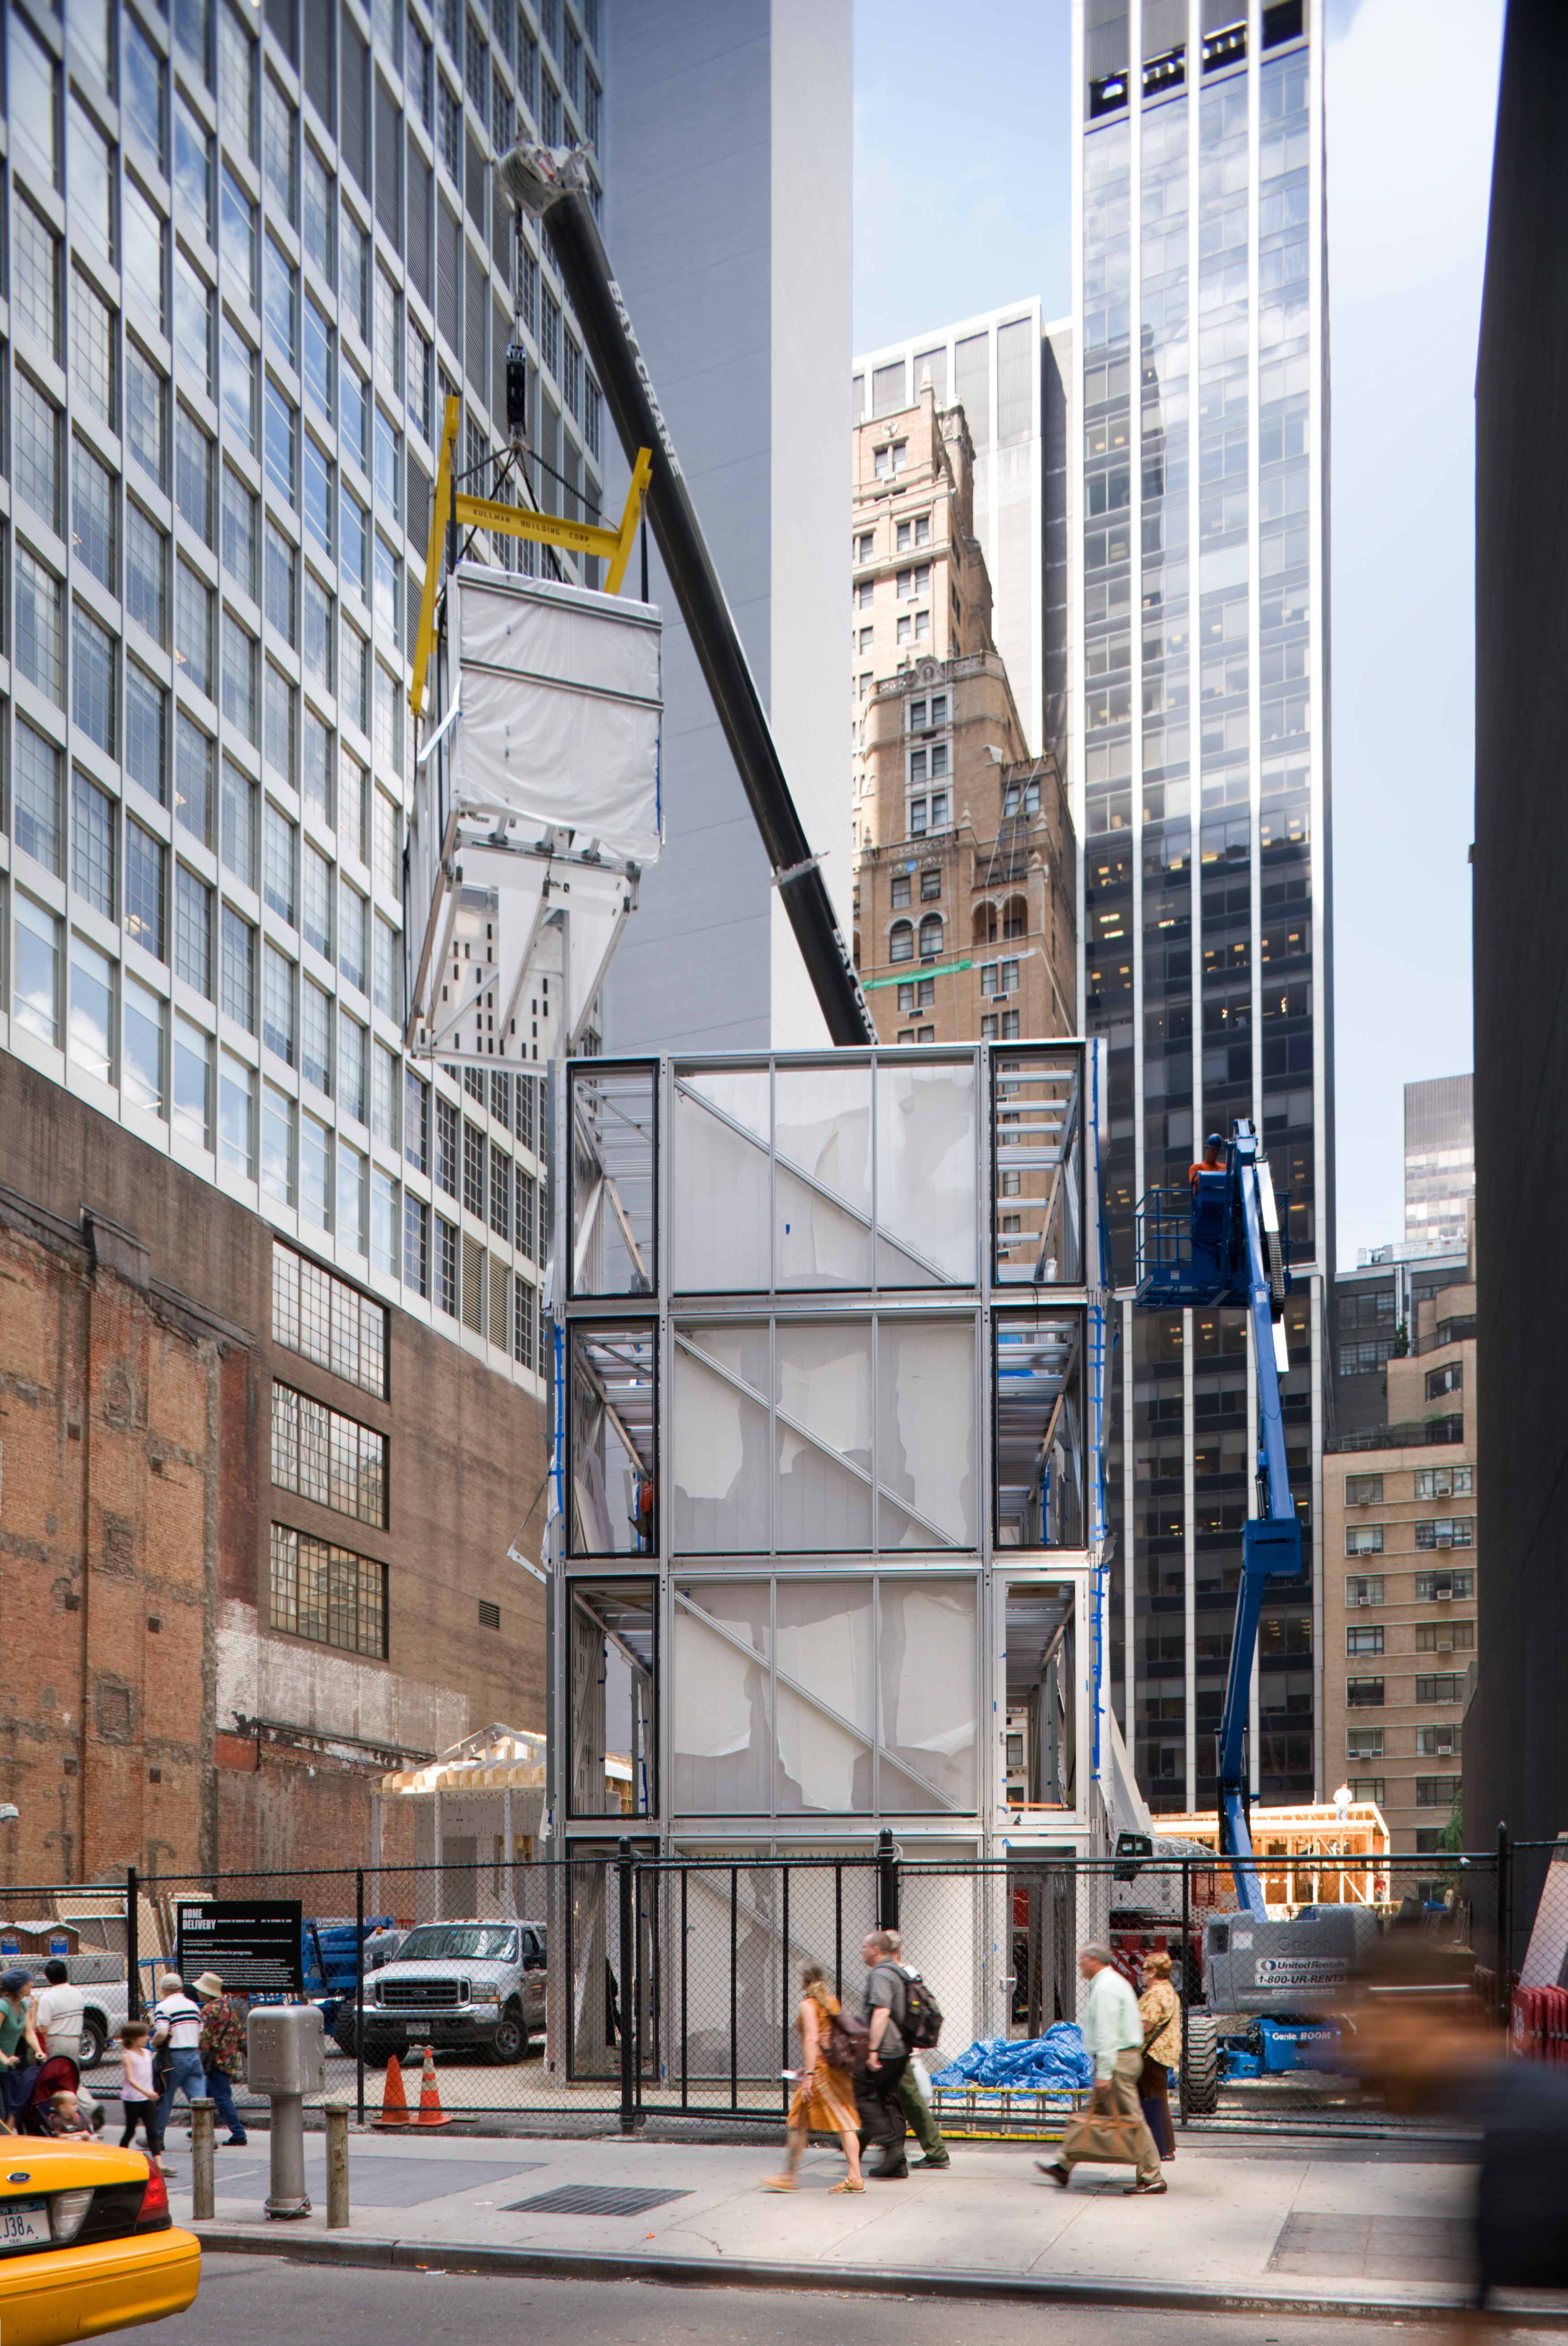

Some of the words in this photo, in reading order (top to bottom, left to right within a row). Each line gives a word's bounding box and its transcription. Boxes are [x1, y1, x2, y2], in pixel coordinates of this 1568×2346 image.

[607, 280, 640, 352] BAY
[635, 356, 686, 479] CRANE
[473, 508, 510, 523] KULLMAN
[521, 520, 560, 536] BUILDING
[569, 532, 589, 542] CORP
[833, 927, 857, 978] BAY
[854, 986, 880, 1045] CRA
[183, 1909, 203, 1918] HOME
[183, 1919, 216, 1930] DELIVERY
[1278, 1961, 1310, 1969] United
[1310, 1960, 1345, 1969] Rentals
[1256, 1974, 1345, 1984] 1-800-UR-RENTS
[1300, 2031, 1331, 2040] BOOM
[0, 2206, 9, 2216] EW
[11, 2203, 30, 2214] YORK
[0, 2216, 35, 2238] J38A
